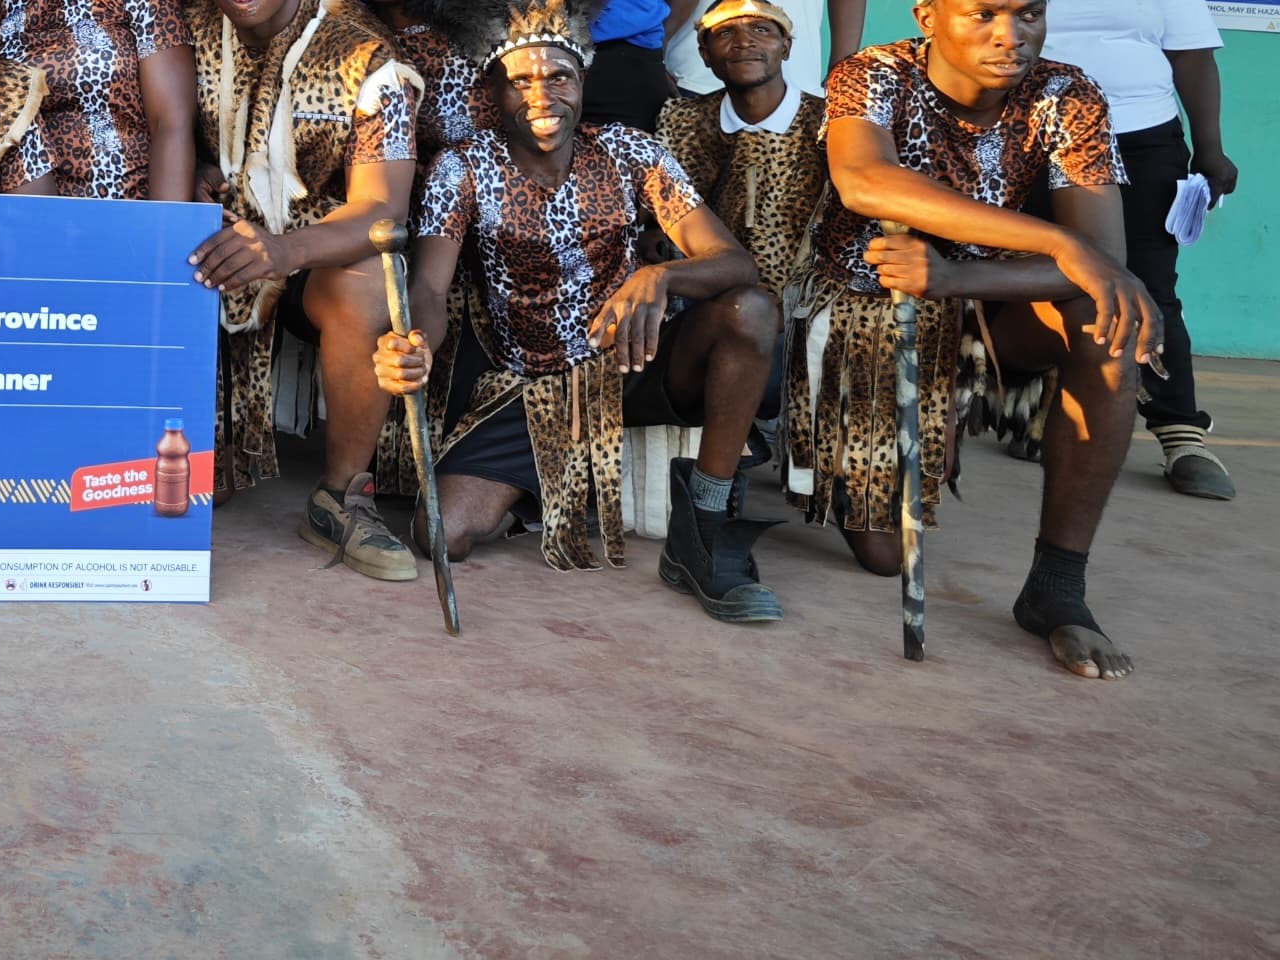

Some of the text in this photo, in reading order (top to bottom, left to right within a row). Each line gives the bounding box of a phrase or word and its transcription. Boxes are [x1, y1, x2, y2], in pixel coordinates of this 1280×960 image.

[1228, 6, 1245, 14] MAY
[1246, 7, 1257, 15] BE
[82, 468, 148, 487] Taste the
[82, 483, 154, 502] Goodness
[61, 562, 73, 571] OF
[76, 562, 117, 571] ALCOHOL
[119, 563, 128, 572] IS
[129, 563, 148, 572] NOT
